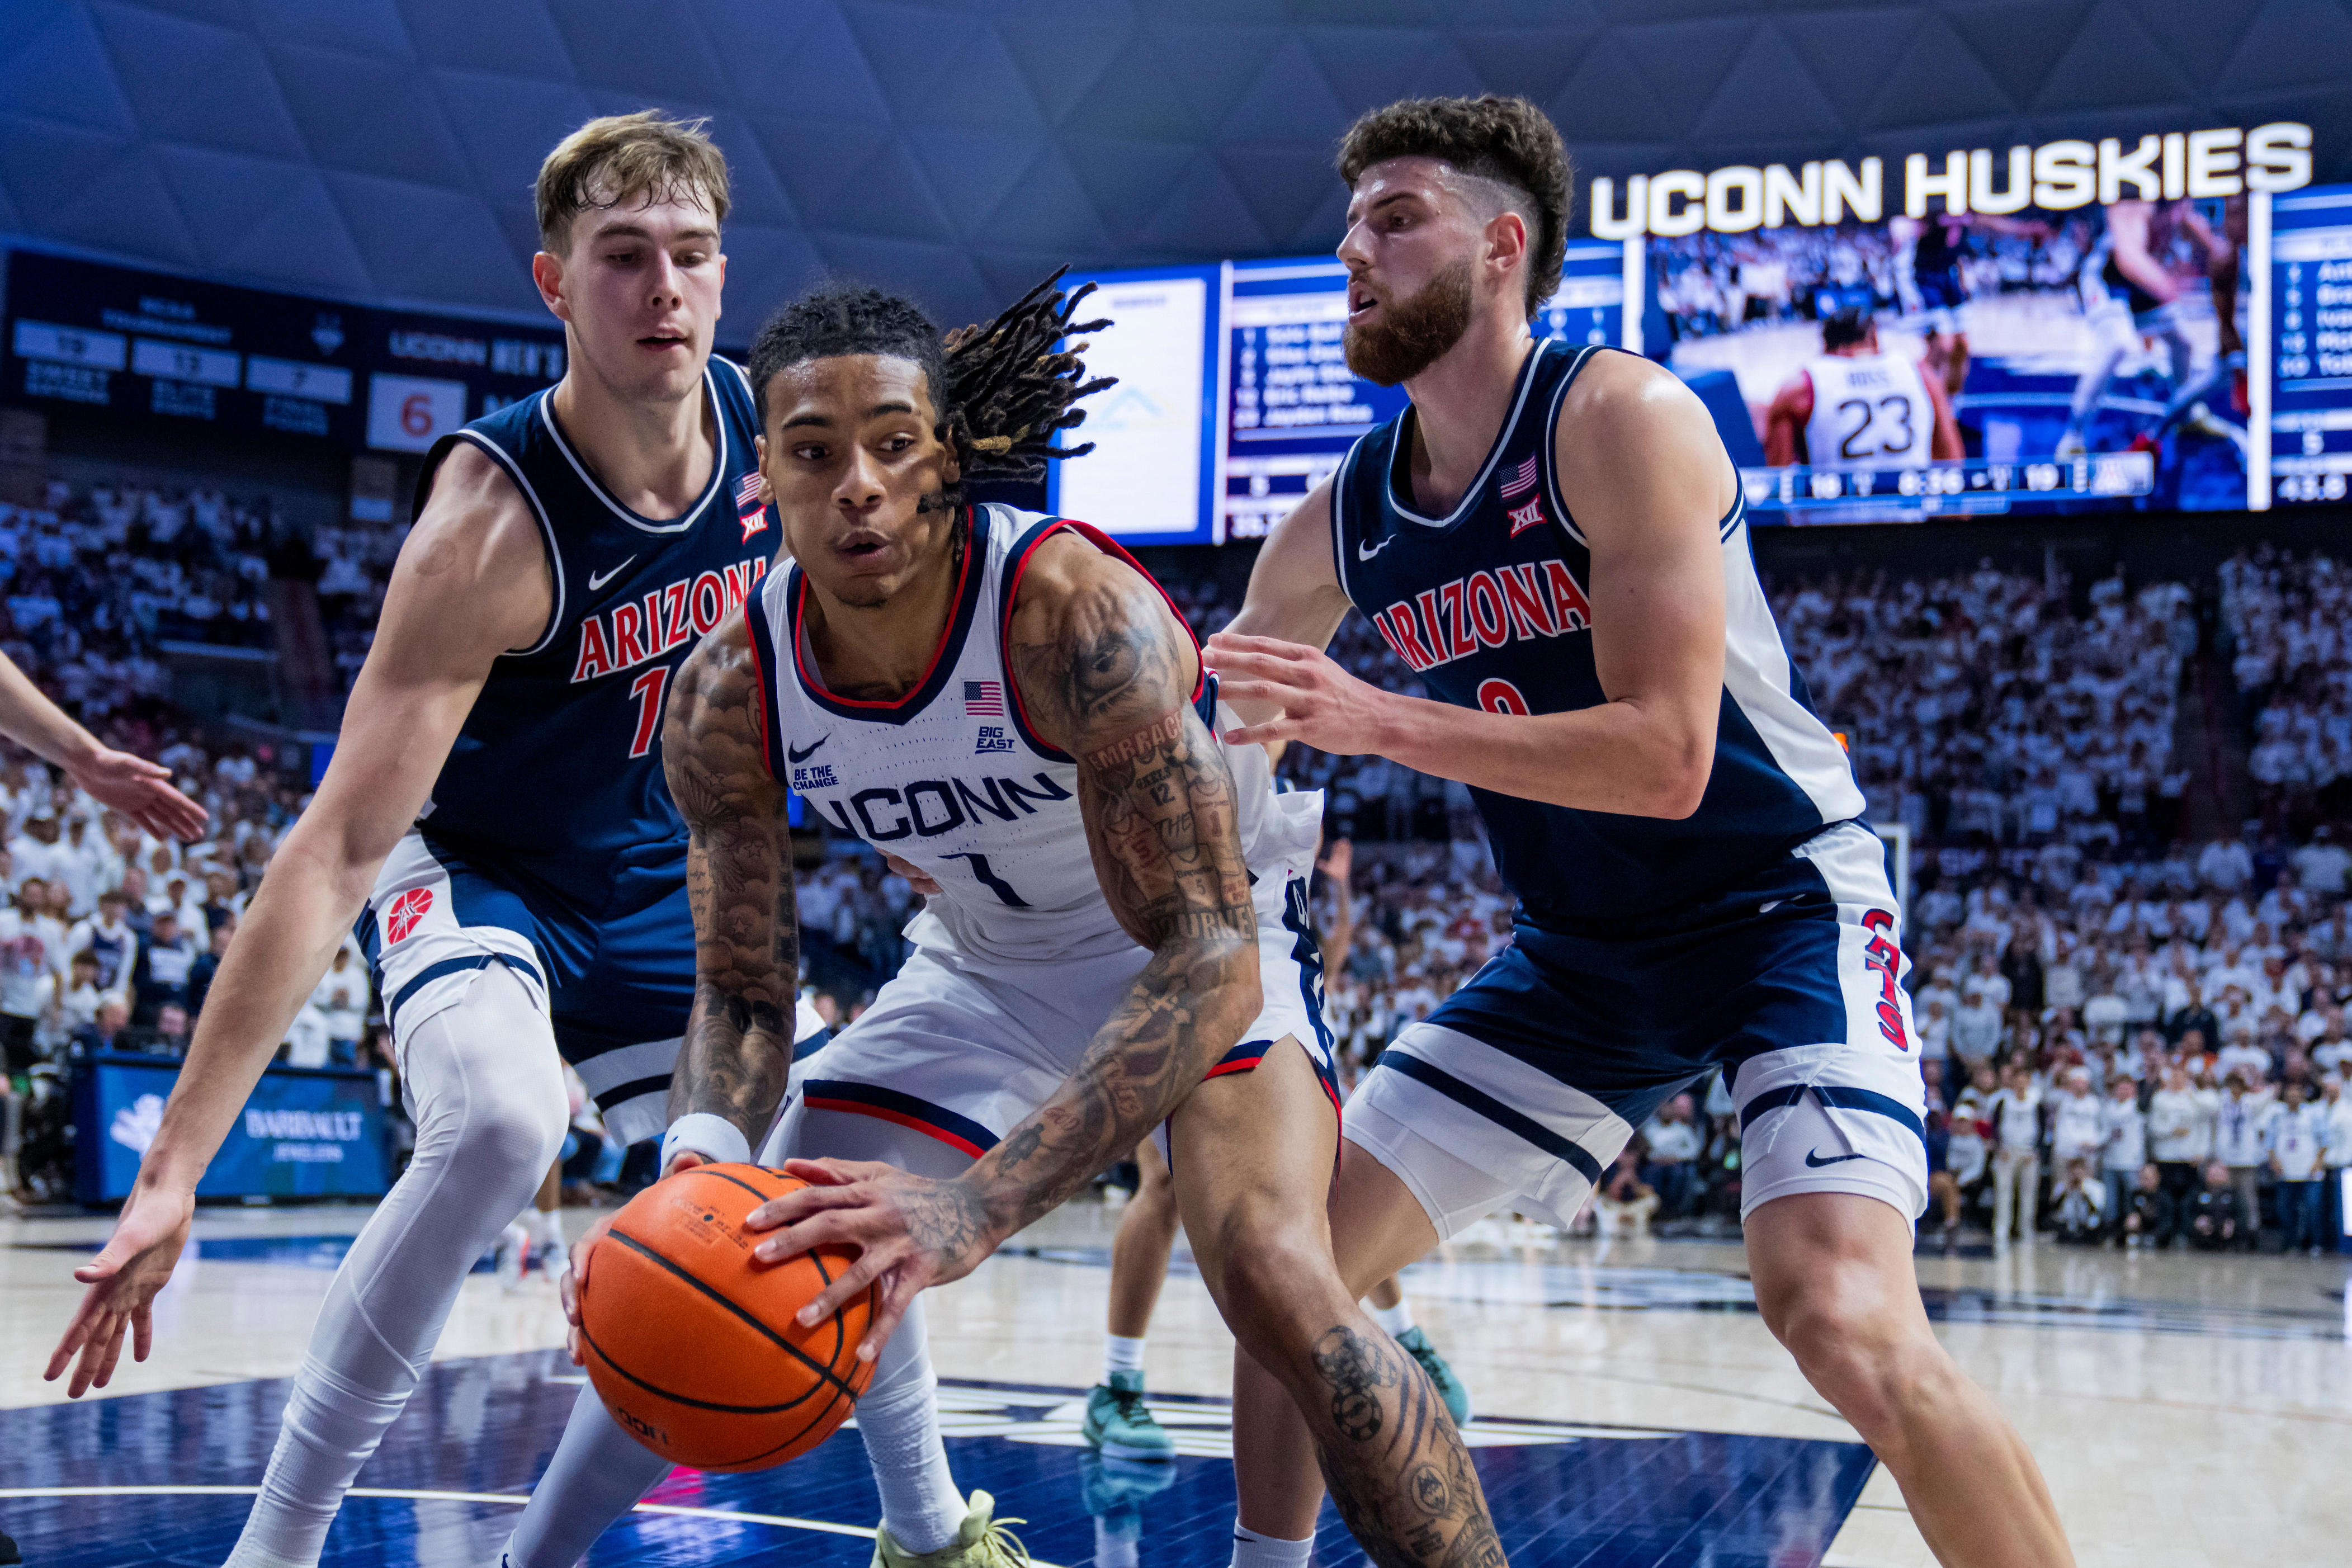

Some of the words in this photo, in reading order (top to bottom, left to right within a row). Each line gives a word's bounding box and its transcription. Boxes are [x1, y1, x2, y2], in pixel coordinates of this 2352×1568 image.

[1590, 156, 1882, 239] UCONN
[1905, 122, 2313, 219] HUSKIES
[400, 394, 433, 437] 6
[1839, 396, 1912, 459] 23
[1373, 559, 1591, 673] ARIZONA
[976, 738, 1015, 749] EAST
[979, 726, 1004, 738] BIG
[792, 776, 838, 791] CHANGE
[794, 768, 809, 781] BE
[809, 765, 833, 779] THE
[1149, 783, 1175, 806] 12
[1154, 811, 1192, 838] THE
[938, 853, 1034, 906] 1
